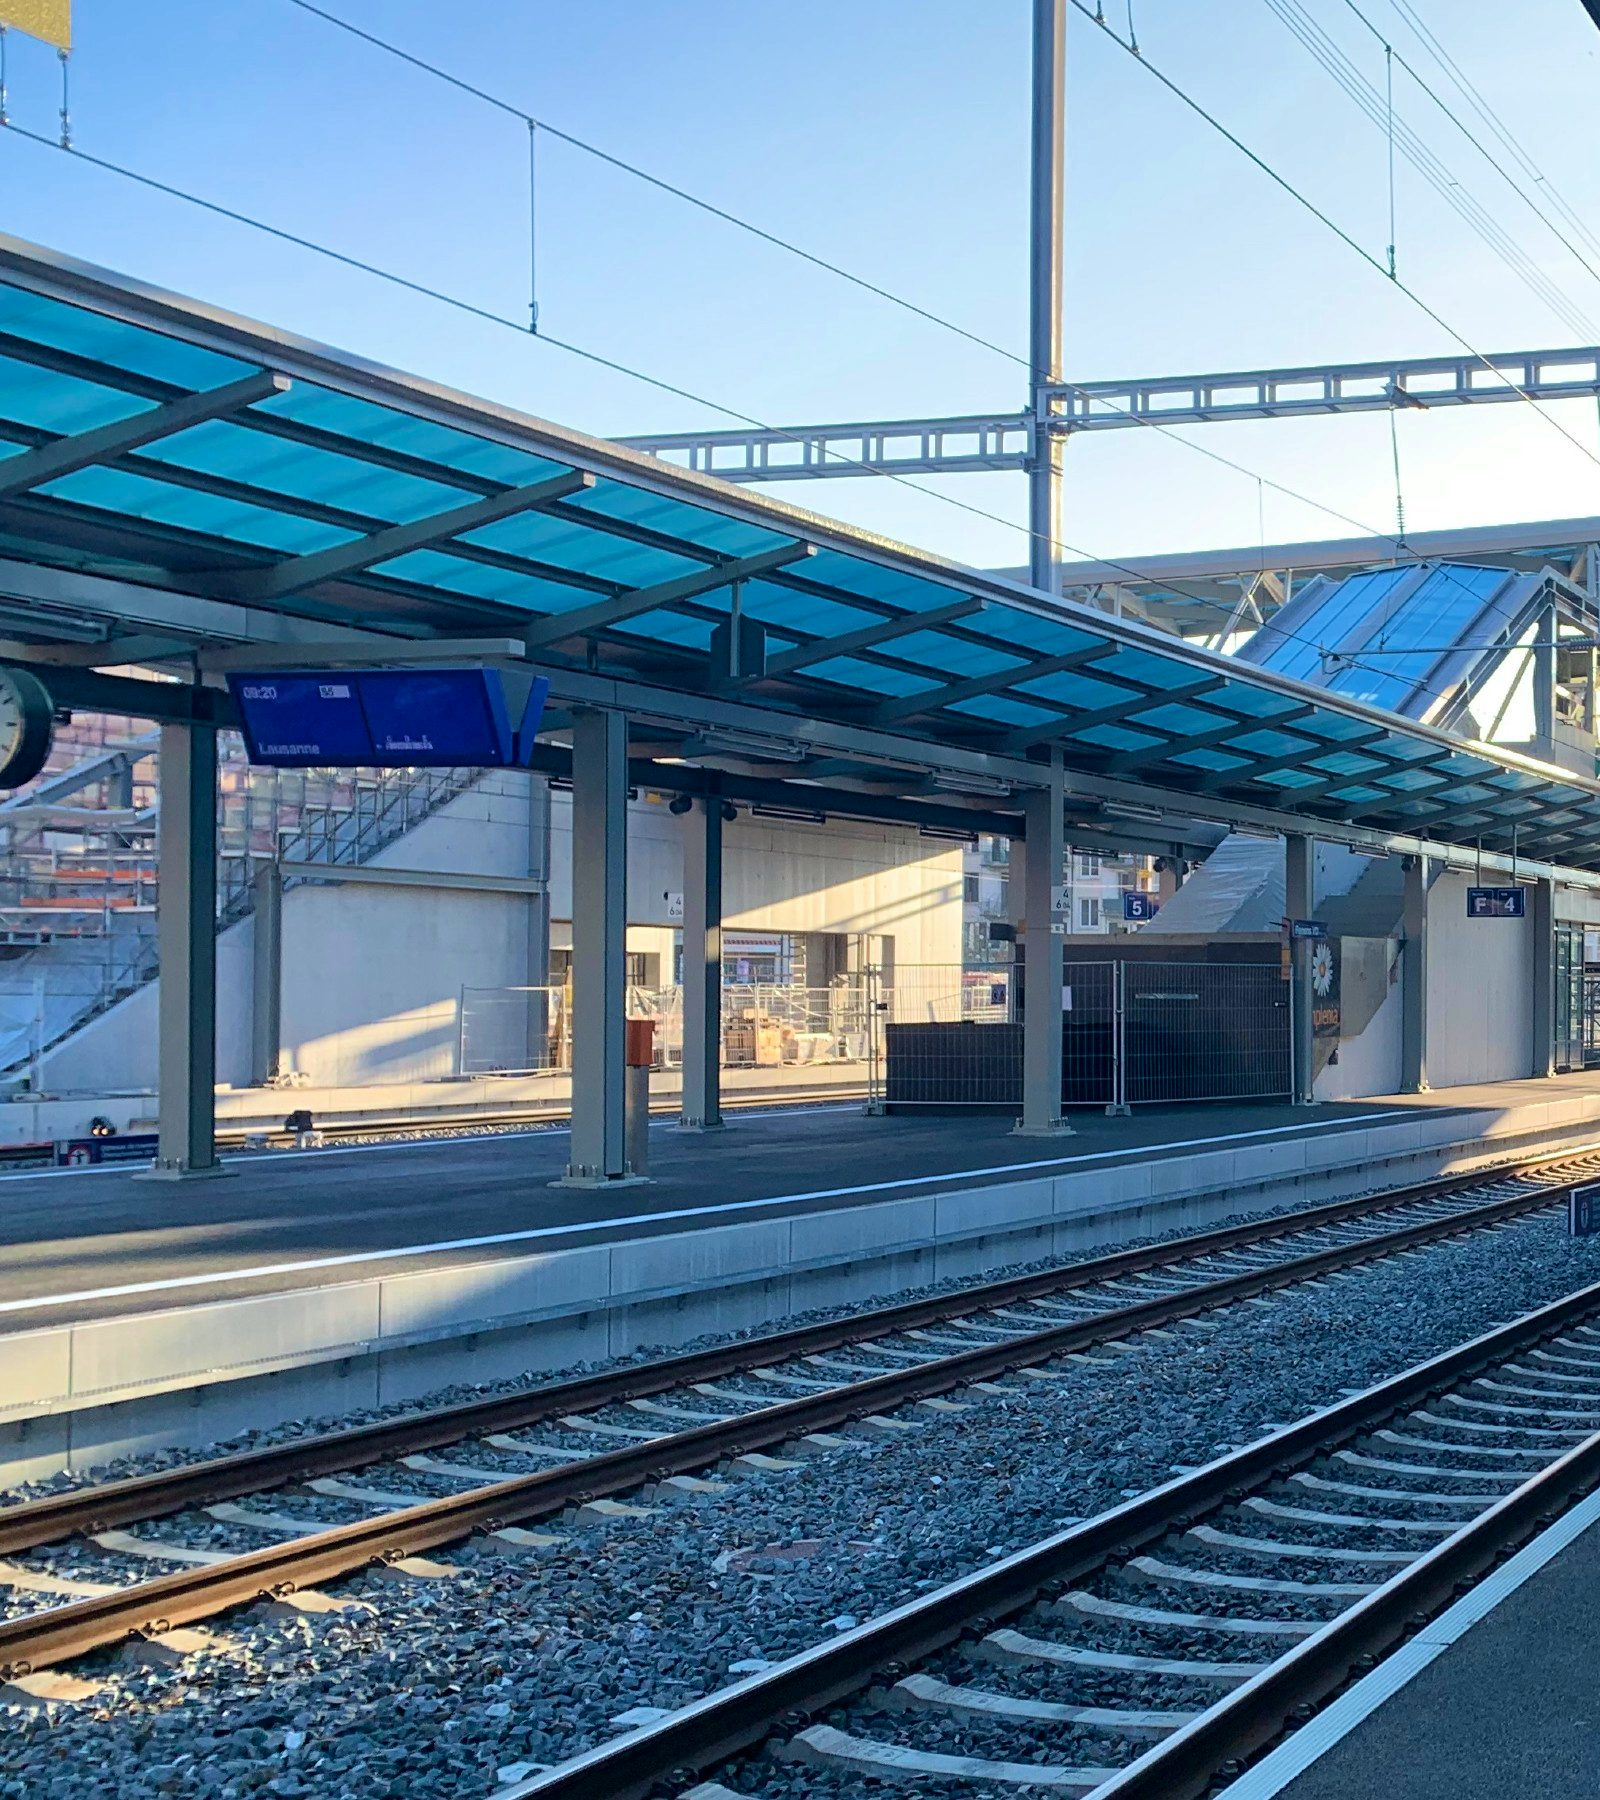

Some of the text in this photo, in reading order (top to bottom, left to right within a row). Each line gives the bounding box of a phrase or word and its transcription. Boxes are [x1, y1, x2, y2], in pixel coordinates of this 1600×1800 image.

[1063, 889, 1069, 898] 4
[676, 897, 681, 905] 4
[1056, 899, 1062, 909] 6
[1475, 897, 1515, 912] F 4
[670, 907, 675, 915] 6
[1132, 901, 1142, 916] 5
[1312, 1003, 1338, 1030] plenia
